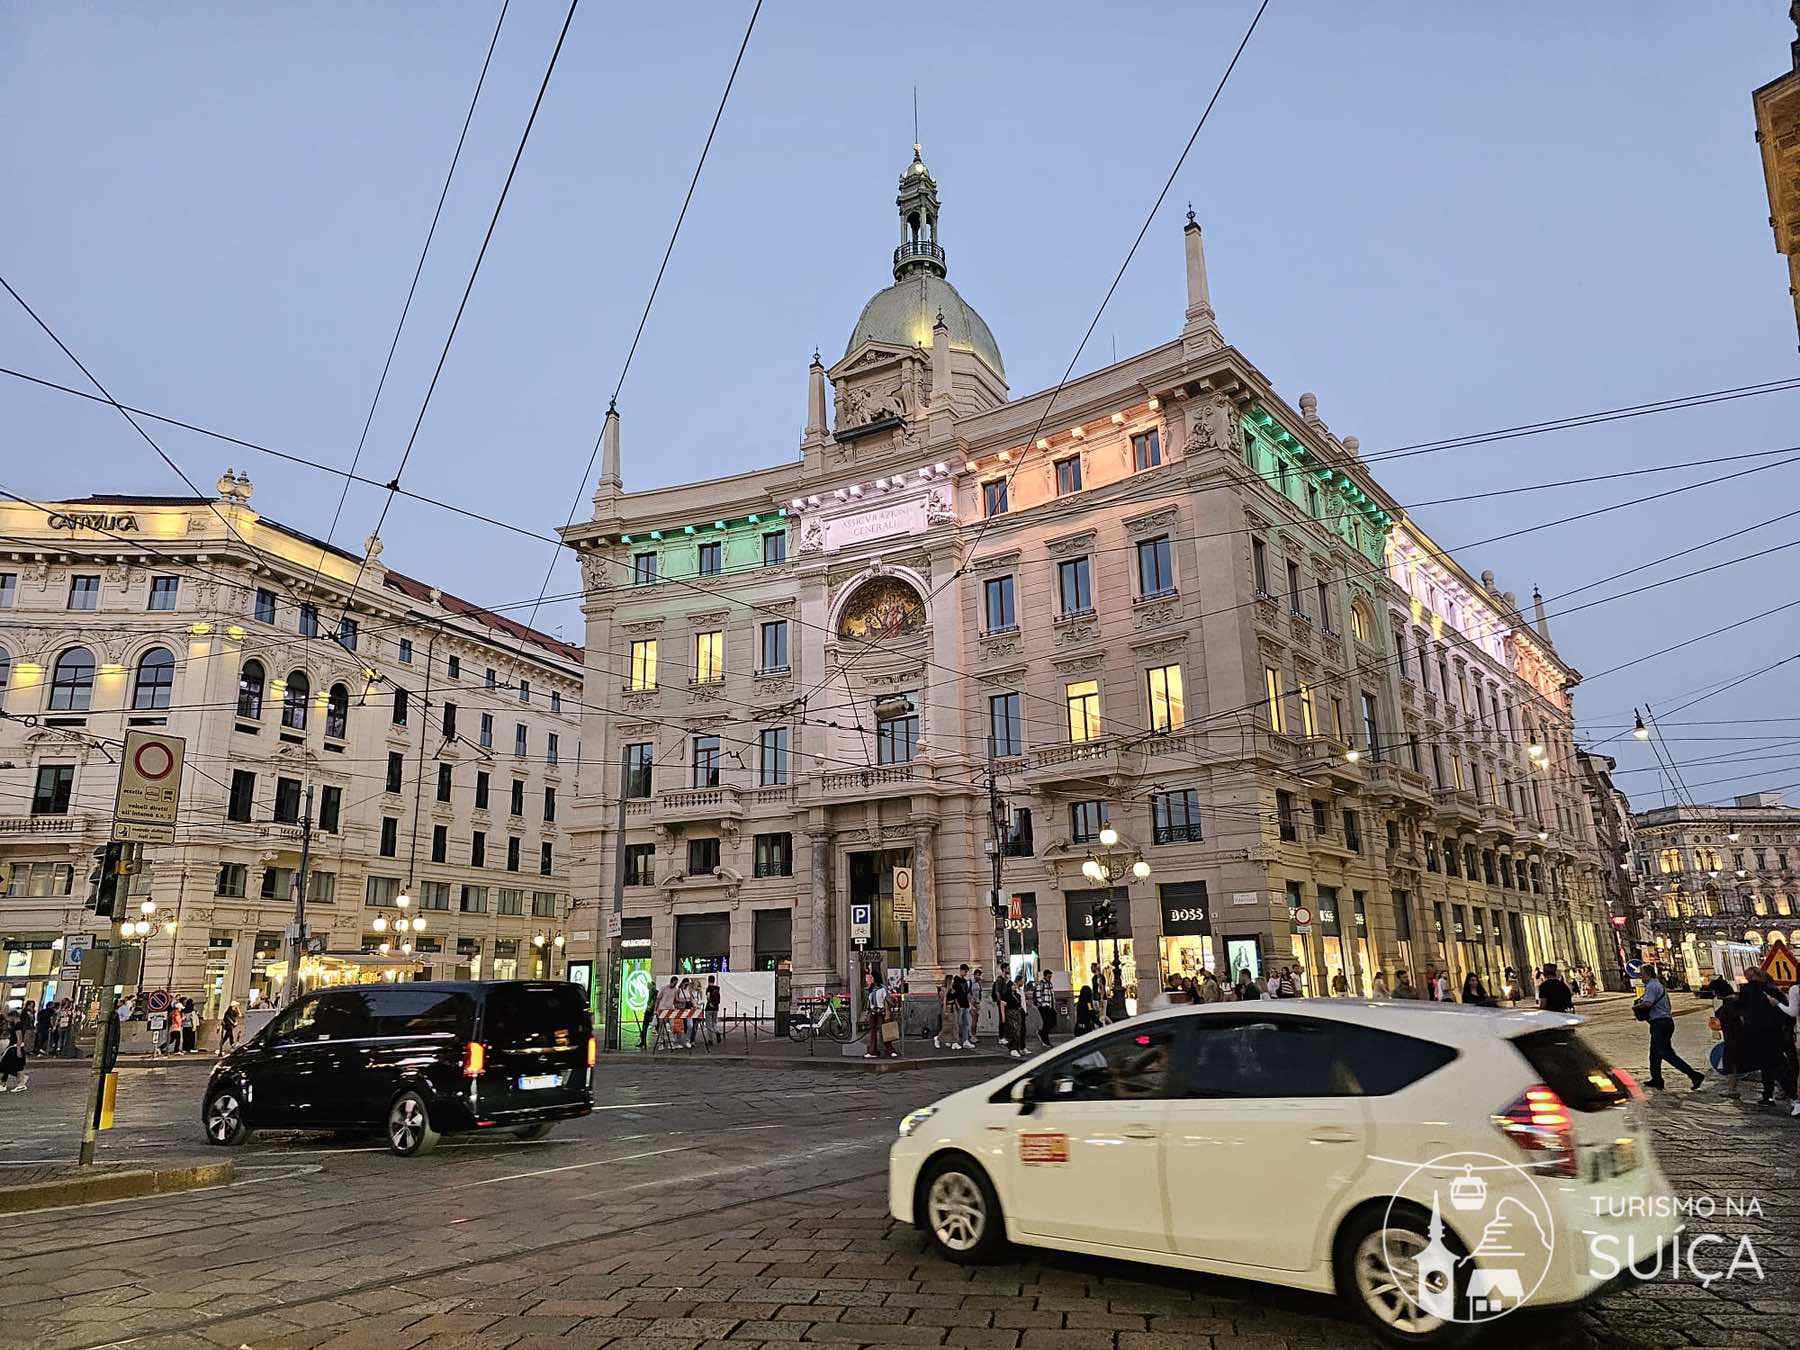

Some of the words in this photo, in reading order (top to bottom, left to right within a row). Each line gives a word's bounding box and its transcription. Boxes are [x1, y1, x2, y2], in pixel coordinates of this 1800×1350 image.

[1012, 900, 1021, 916] M
[1170, 908, 1204, 921] BOSS
[856, 908, 866, 923] P
[1004, 917, 1034, 930] BOSS
